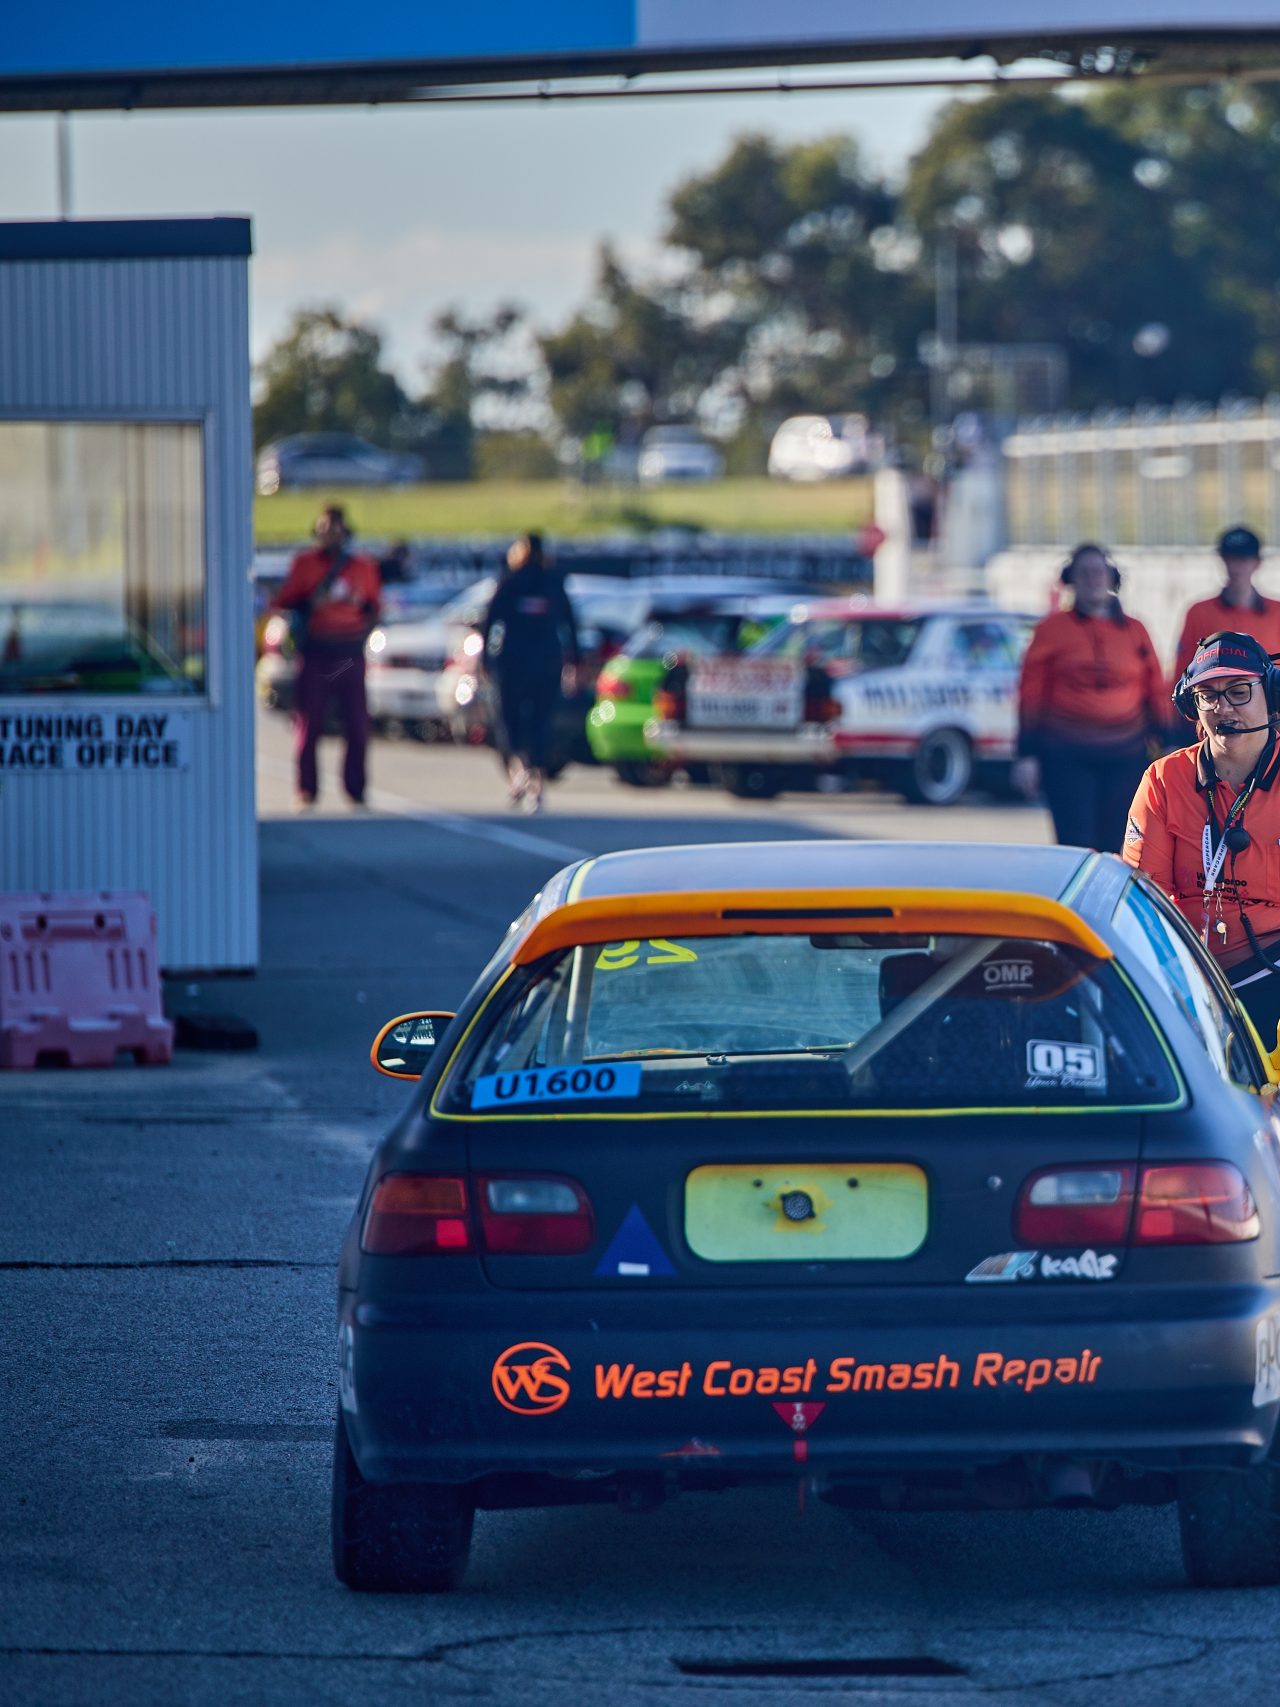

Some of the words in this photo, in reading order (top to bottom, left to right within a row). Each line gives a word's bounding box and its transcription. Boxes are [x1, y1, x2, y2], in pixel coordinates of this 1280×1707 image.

[1197, 646, 1247, 664] OFFICIAL
[0, 713, 103, 740] TUNING
[116, 713, 168, 739] DAY
[0, 743, 63, 768] ACE
[76, 742, 179, 768] OFFICE
[984, 964, 1034, 984] OMP
[1033, 1044, 1094, 1076] 05
[595, 1361, 693, 1399] West
[702, 1358, 817, 1397] Coast
[826, 1353, 961, 1392] Smash
[972, 1348, 1102, 1392] Repair
